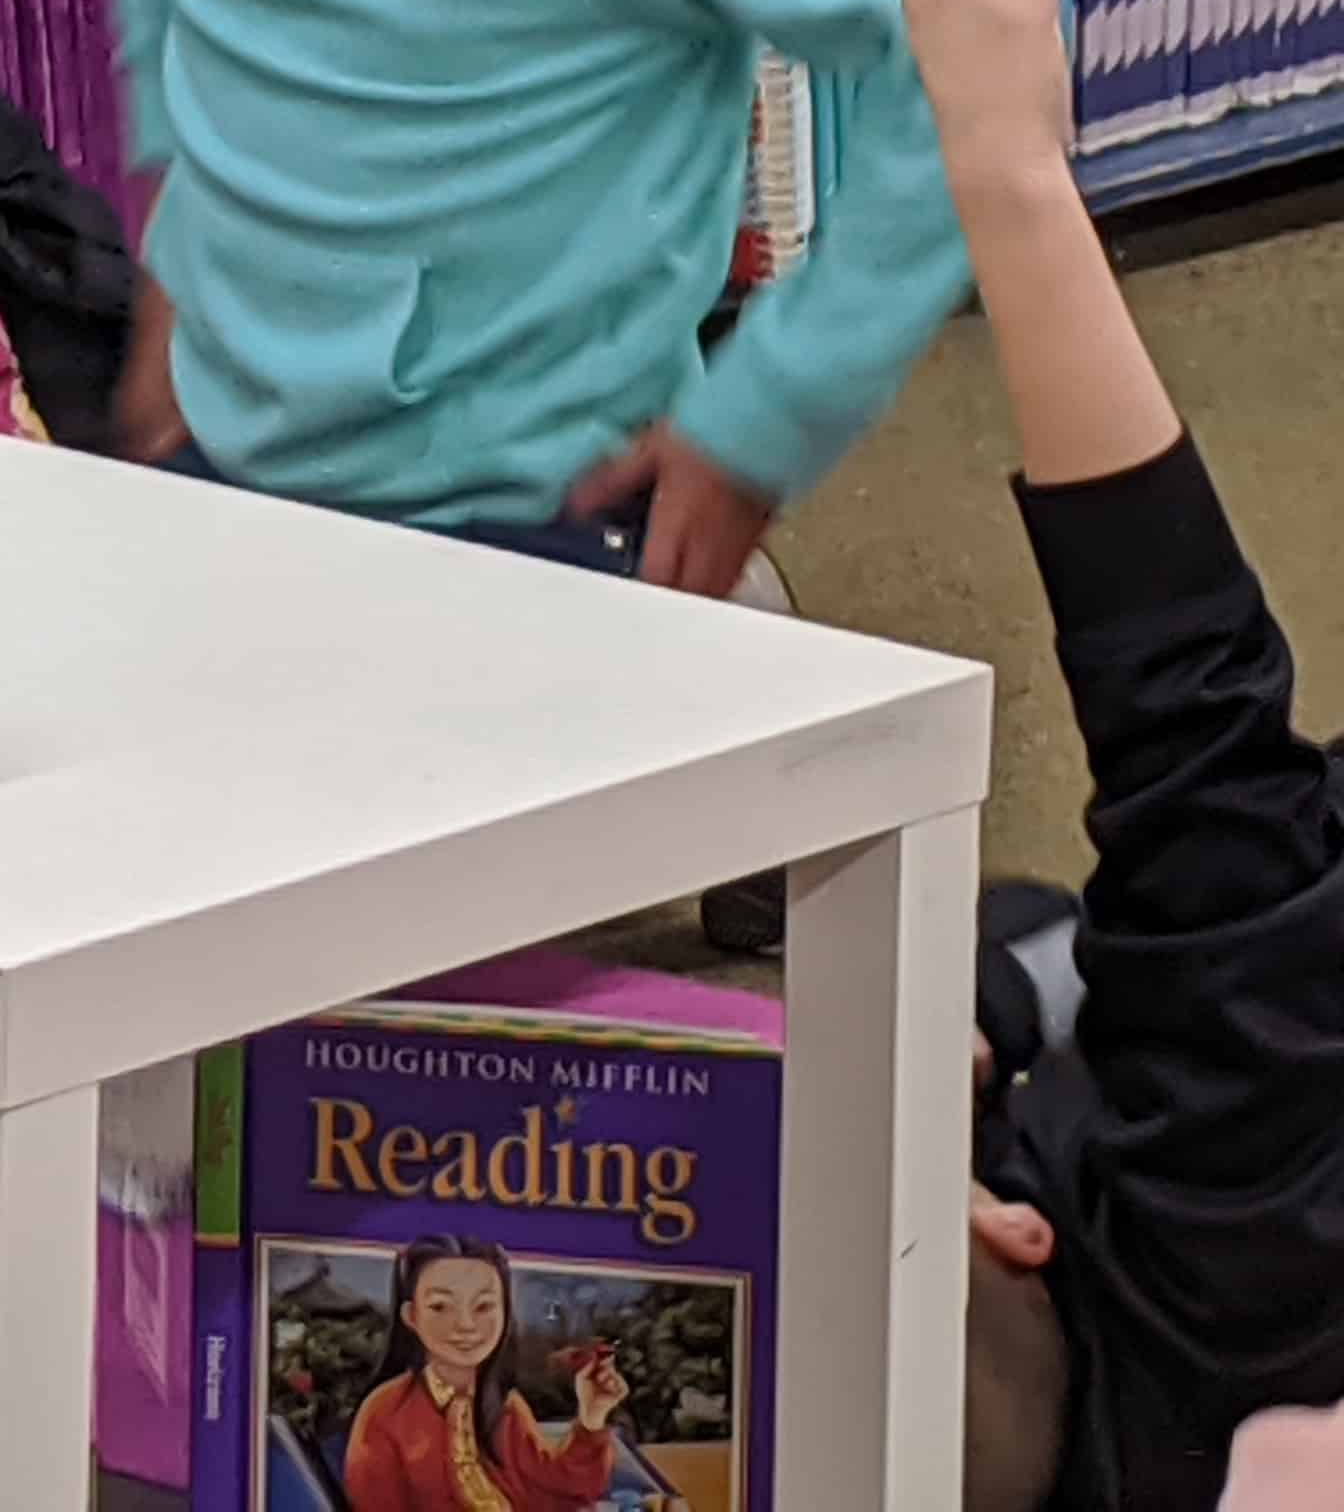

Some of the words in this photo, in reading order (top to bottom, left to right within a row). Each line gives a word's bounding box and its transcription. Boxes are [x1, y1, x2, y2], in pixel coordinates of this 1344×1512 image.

[305, 1039, 536, 1084] HOUGHTON
[550, 1059, 711, 1096] MIFFLIN
[308, 1096, 698, 1246] Reading
